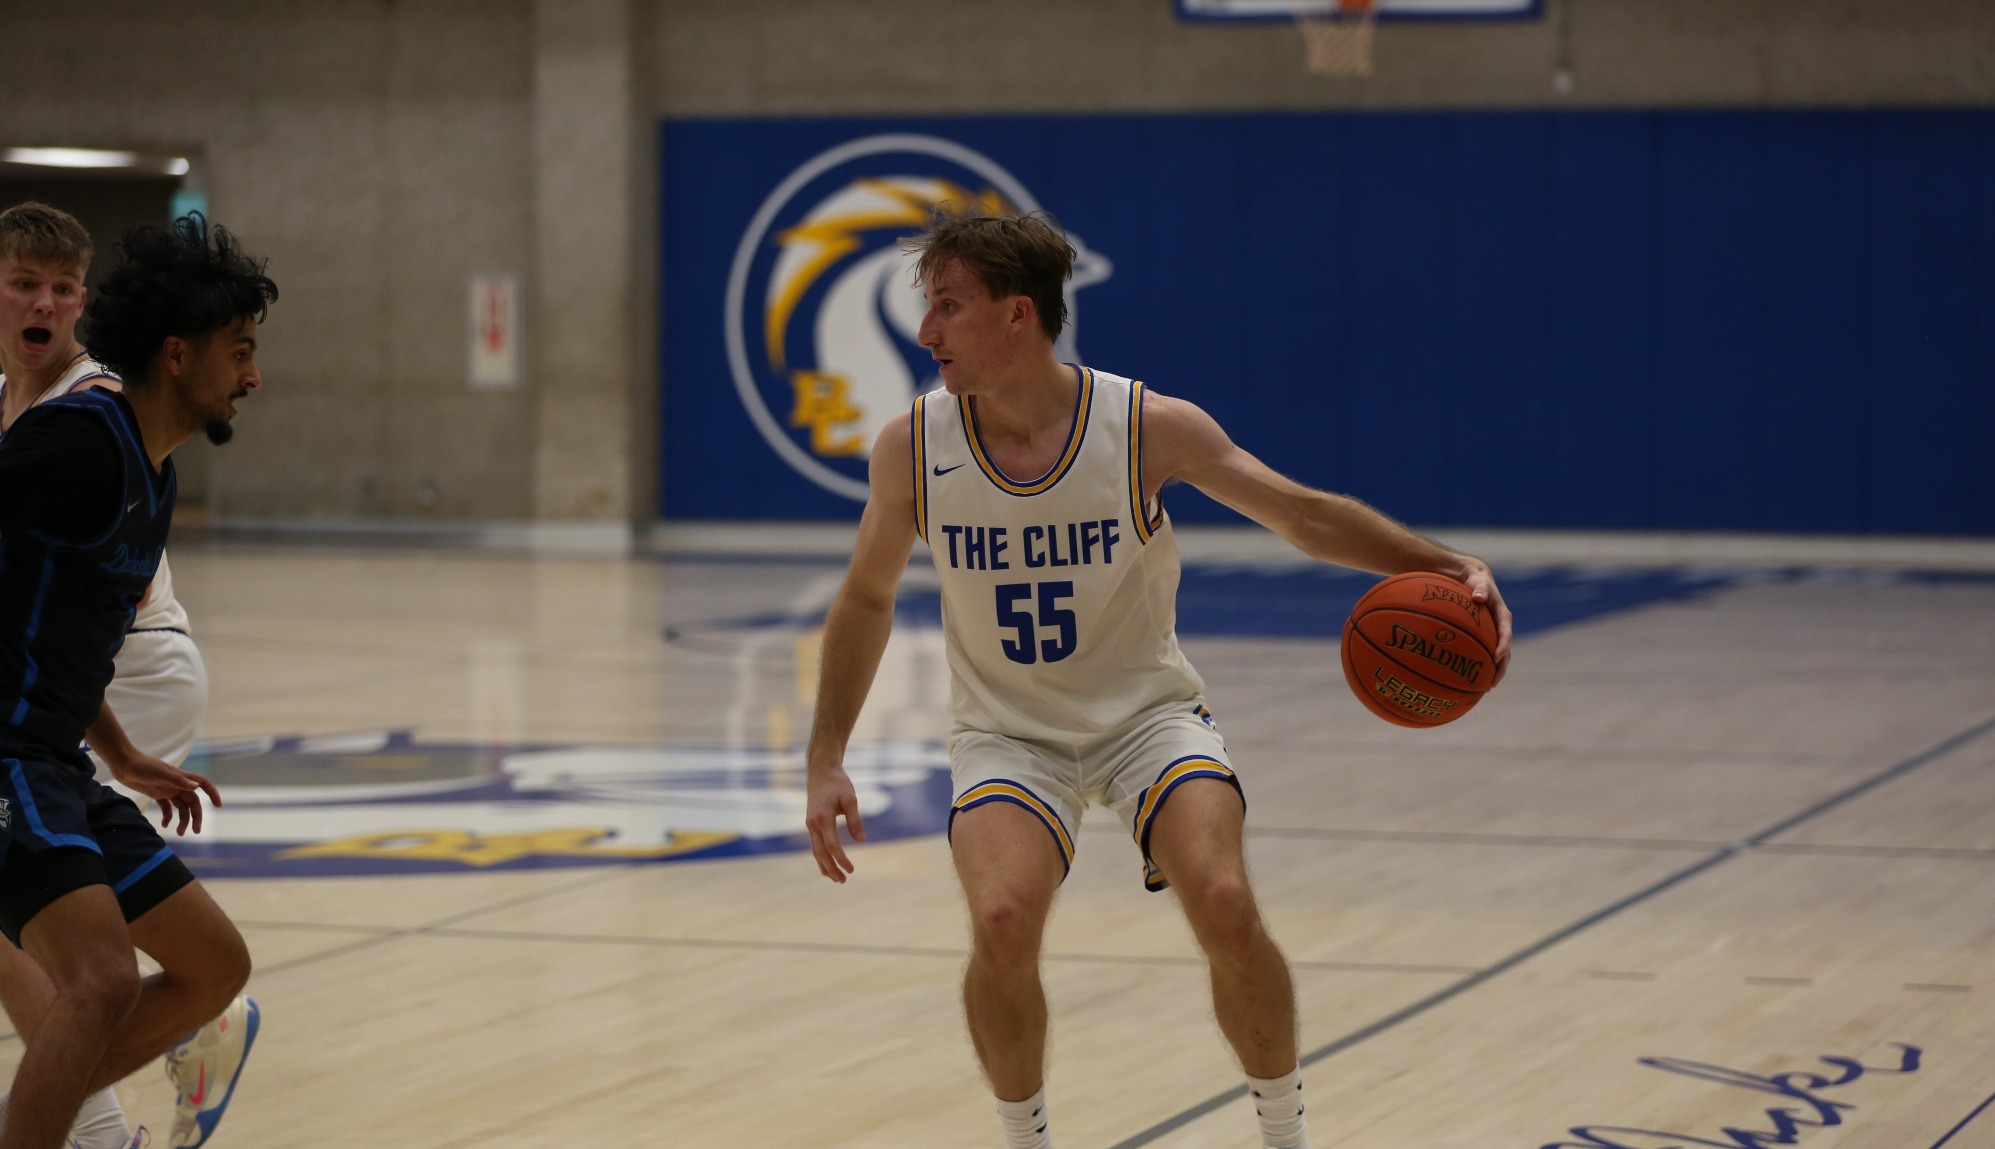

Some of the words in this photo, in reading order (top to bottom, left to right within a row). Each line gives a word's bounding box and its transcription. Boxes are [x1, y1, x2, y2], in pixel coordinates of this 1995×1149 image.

[941, 524, 1010, 571] THE
[1022, 518, 1120, 569] CLIFF
[995, 580, 1078, 665] 55
[1385, 623, 1483, 684] SPALDING
[1373, 665, 1457, 711] LEGACY
